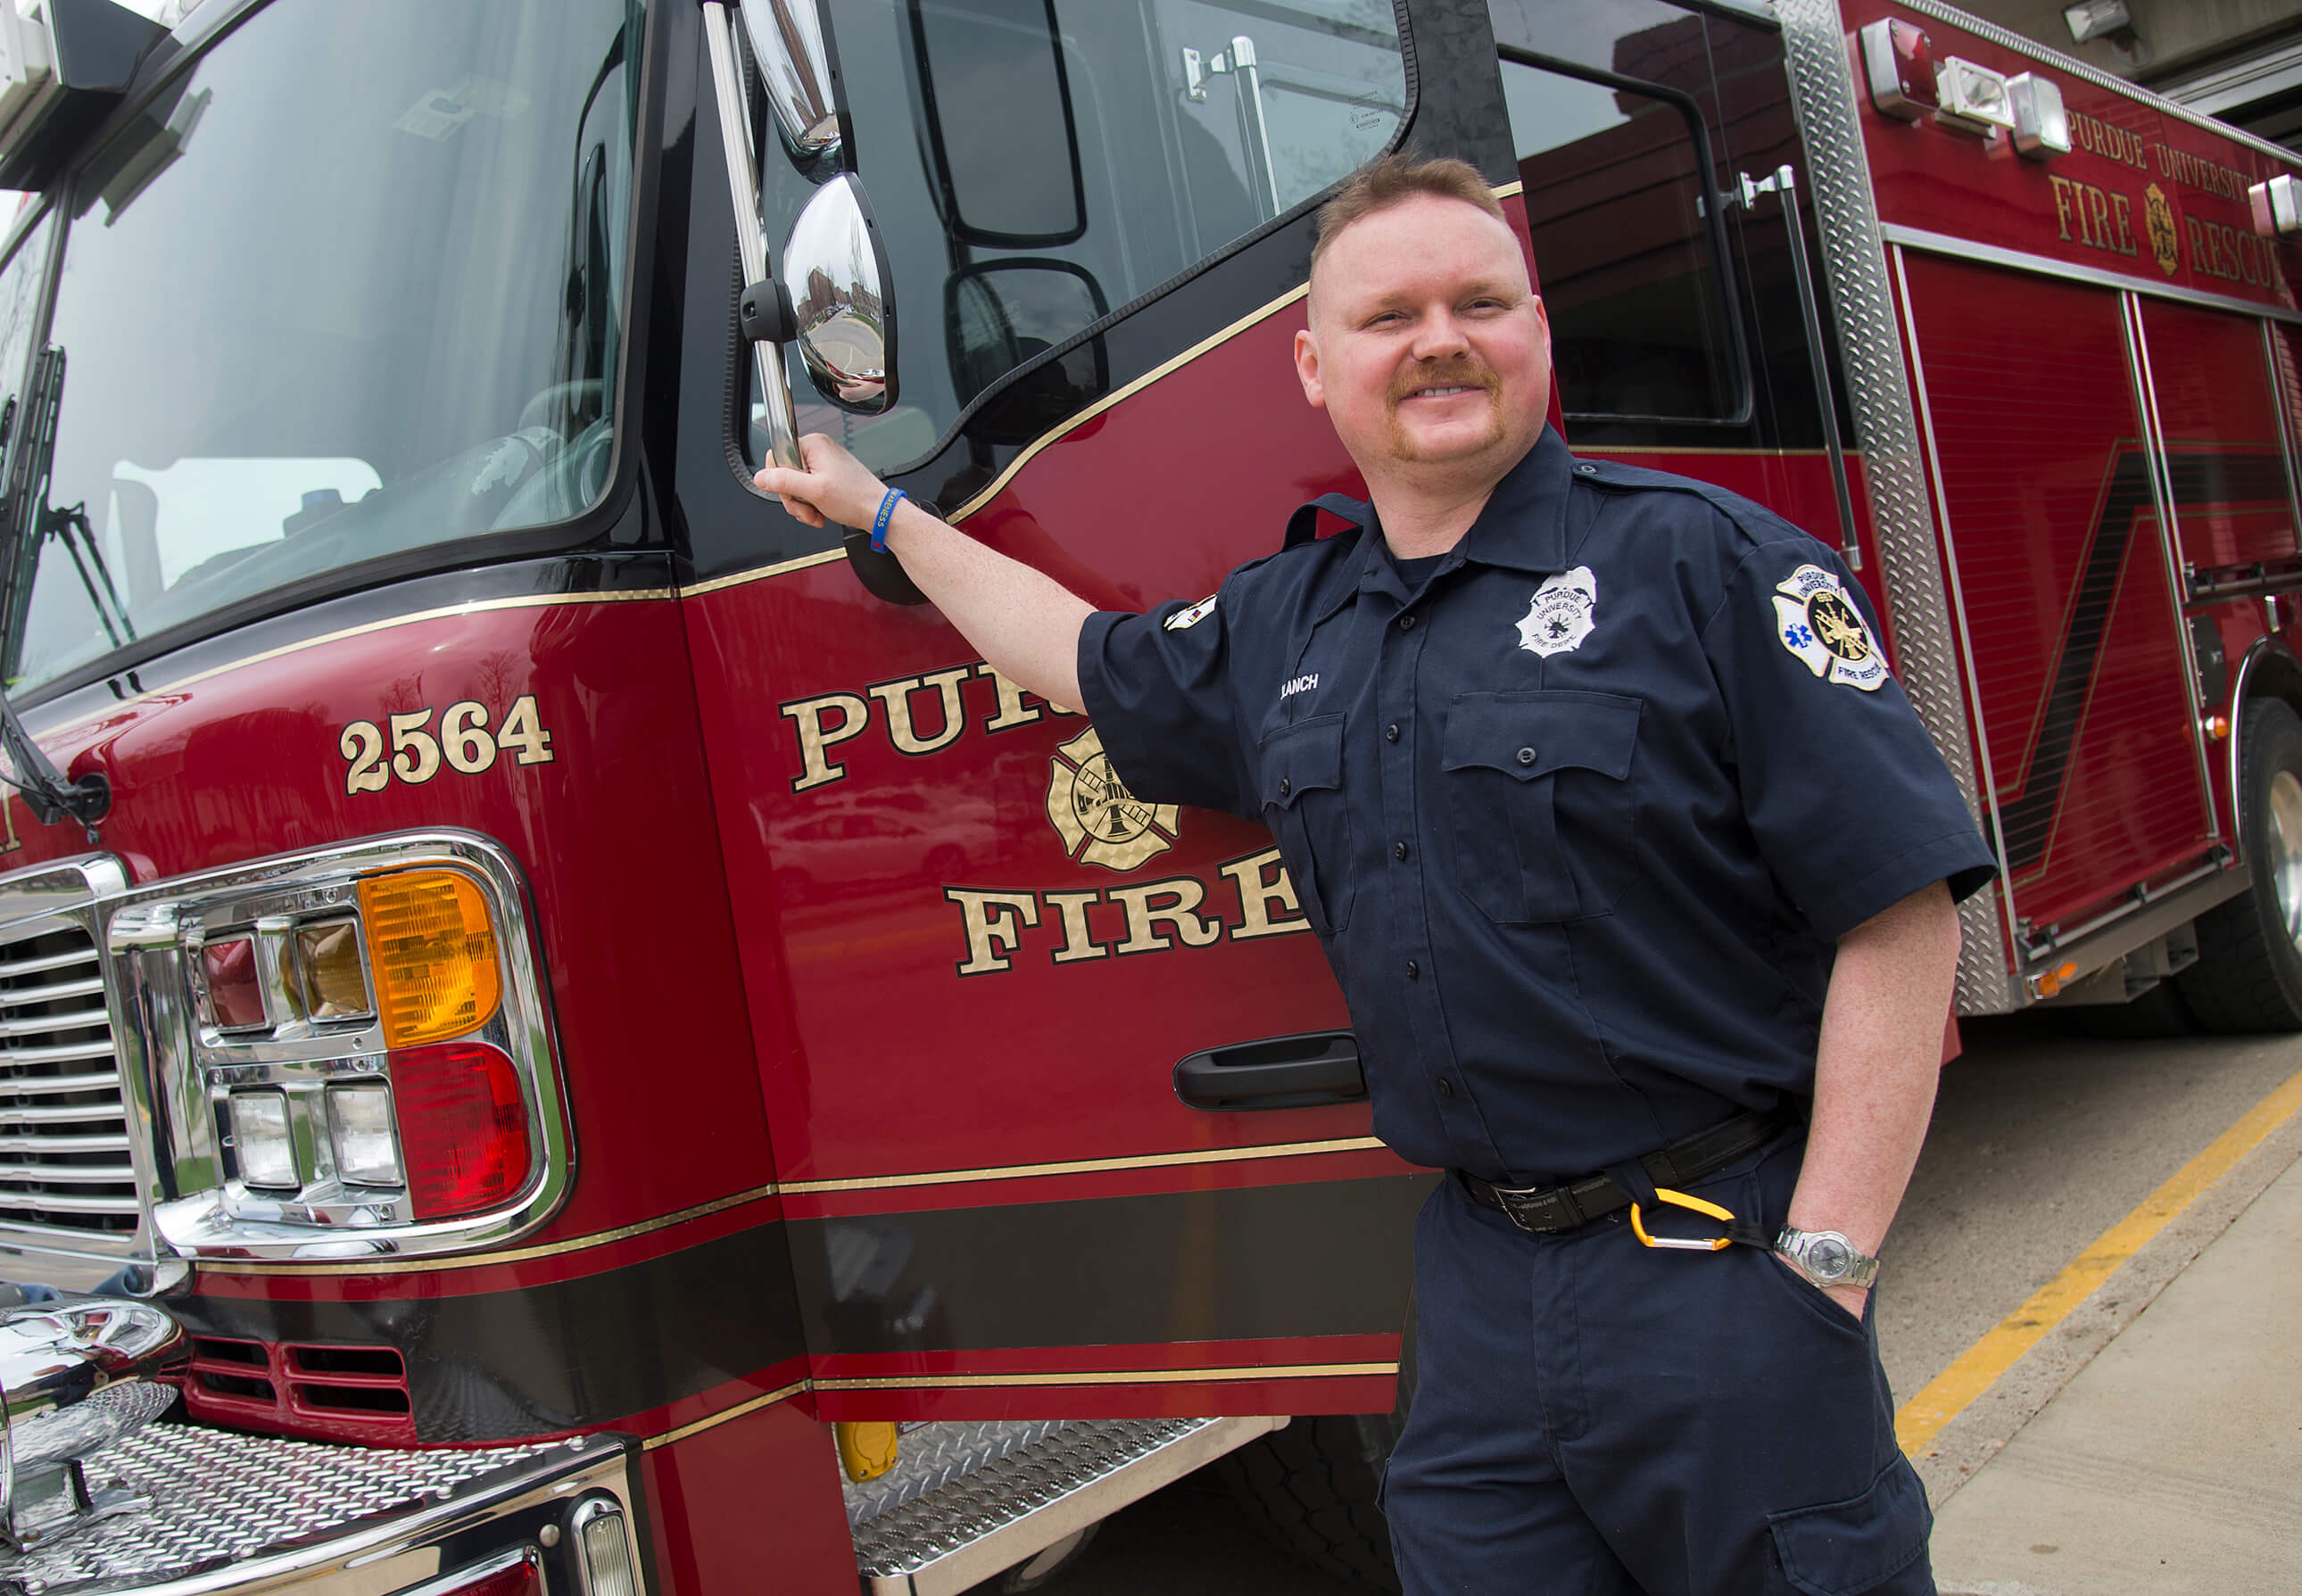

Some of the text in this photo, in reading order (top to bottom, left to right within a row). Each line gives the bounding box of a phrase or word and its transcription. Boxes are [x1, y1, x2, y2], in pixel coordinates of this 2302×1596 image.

[2065, 109, 2148, 170] PURDUE
[2049, 173, 2138, 258] FIRE
[1545, 591, 1581, 603] PURDUE
[1536, 603, 1582, 620] UNIVERSITY
[1532, 633, 1548, 648] FIRE
[1838, 666, 1859, 680] FIRE
[340, 695, 555, 796] 2564
